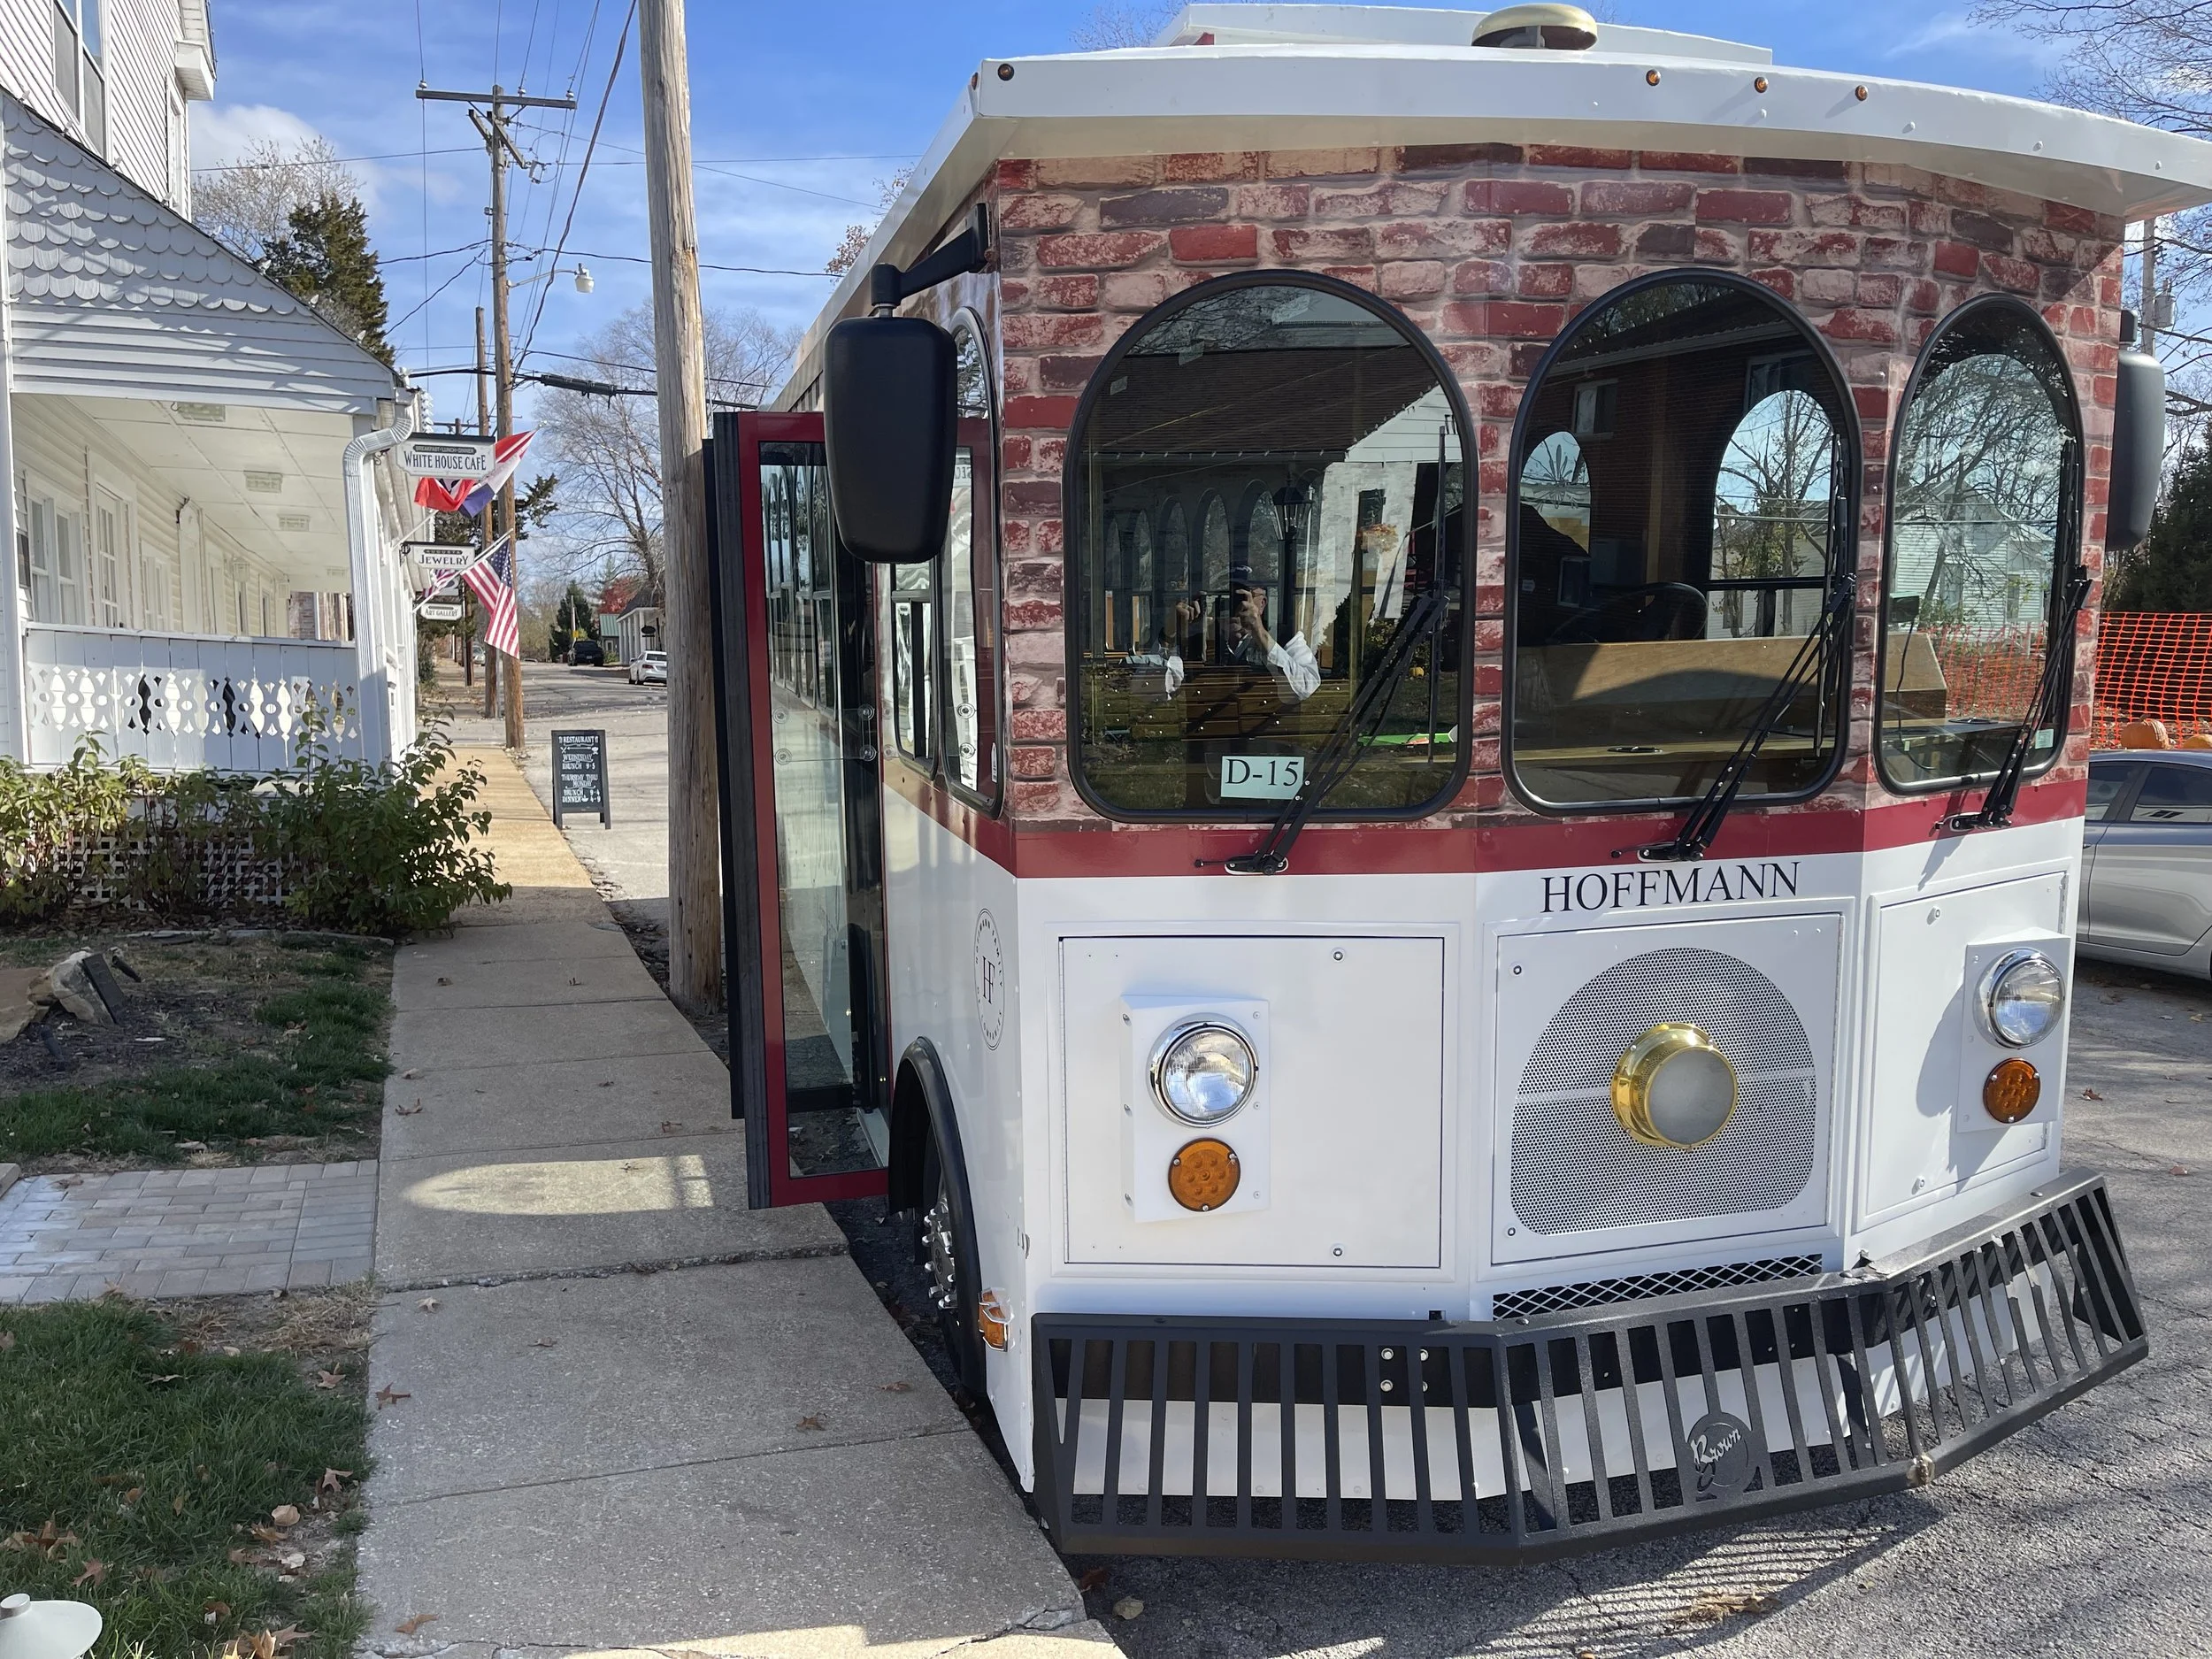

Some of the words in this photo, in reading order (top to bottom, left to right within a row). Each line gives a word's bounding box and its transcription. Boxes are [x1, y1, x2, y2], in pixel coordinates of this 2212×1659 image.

[403, 450, 433, 468] WHITE
[434, 455, 463, 470] HOUSE
[465, 454, 487, 471] CAFE
[419, 554, 469, 565] JEWELRY
[1225, 758, 1300, 787] D-15
[1540, 861, 1802, 914] HOFFMANN
